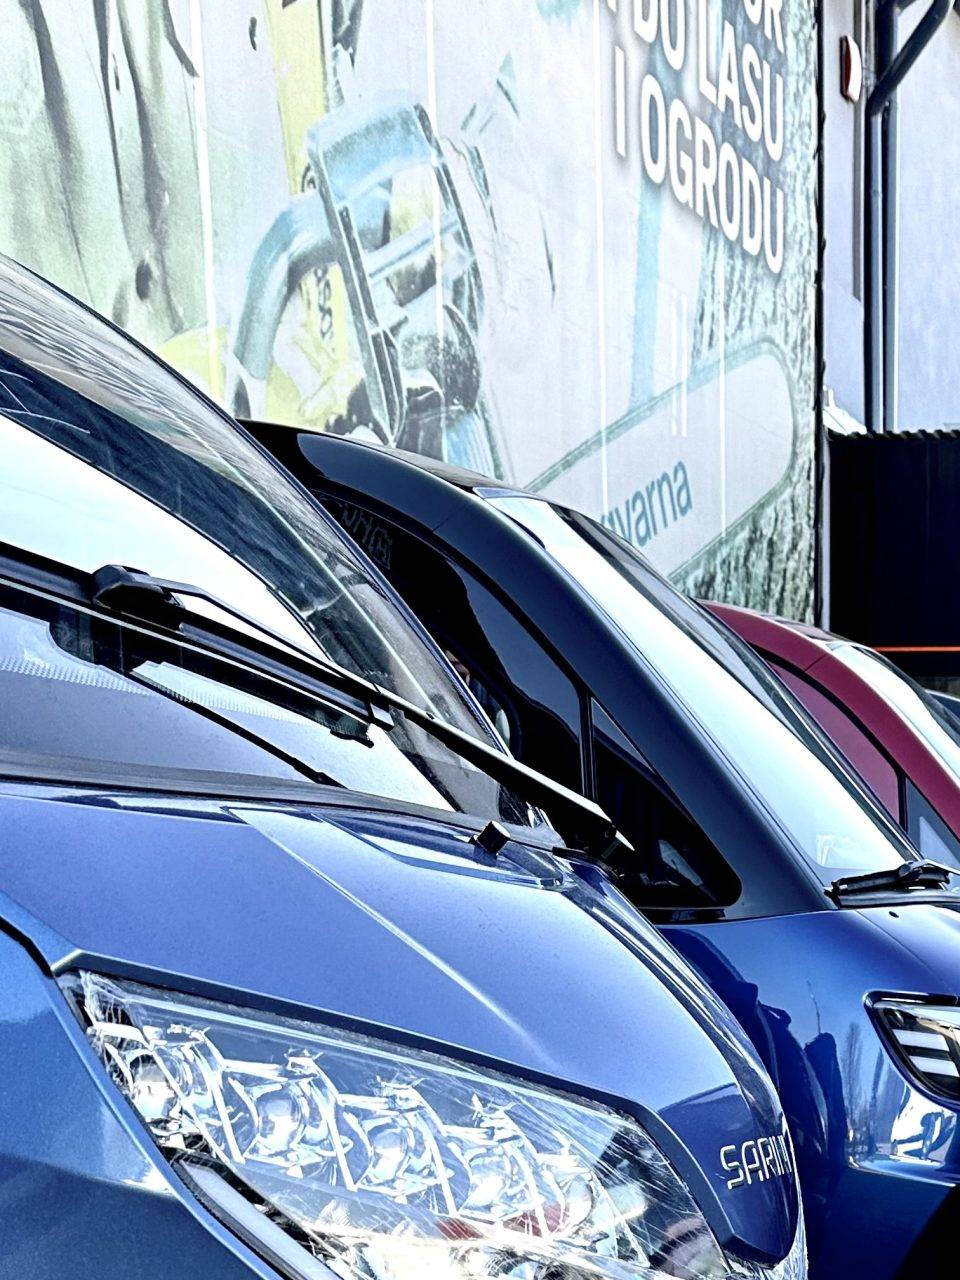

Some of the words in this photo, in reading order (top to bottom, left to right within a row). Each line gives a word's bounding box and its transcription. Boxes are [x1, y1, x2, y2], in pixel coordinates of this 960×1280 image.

[614, 45, 626, 158] I
[641, 74, 784, 274] OGRODU
[699, 0, 784, 162] LASU
